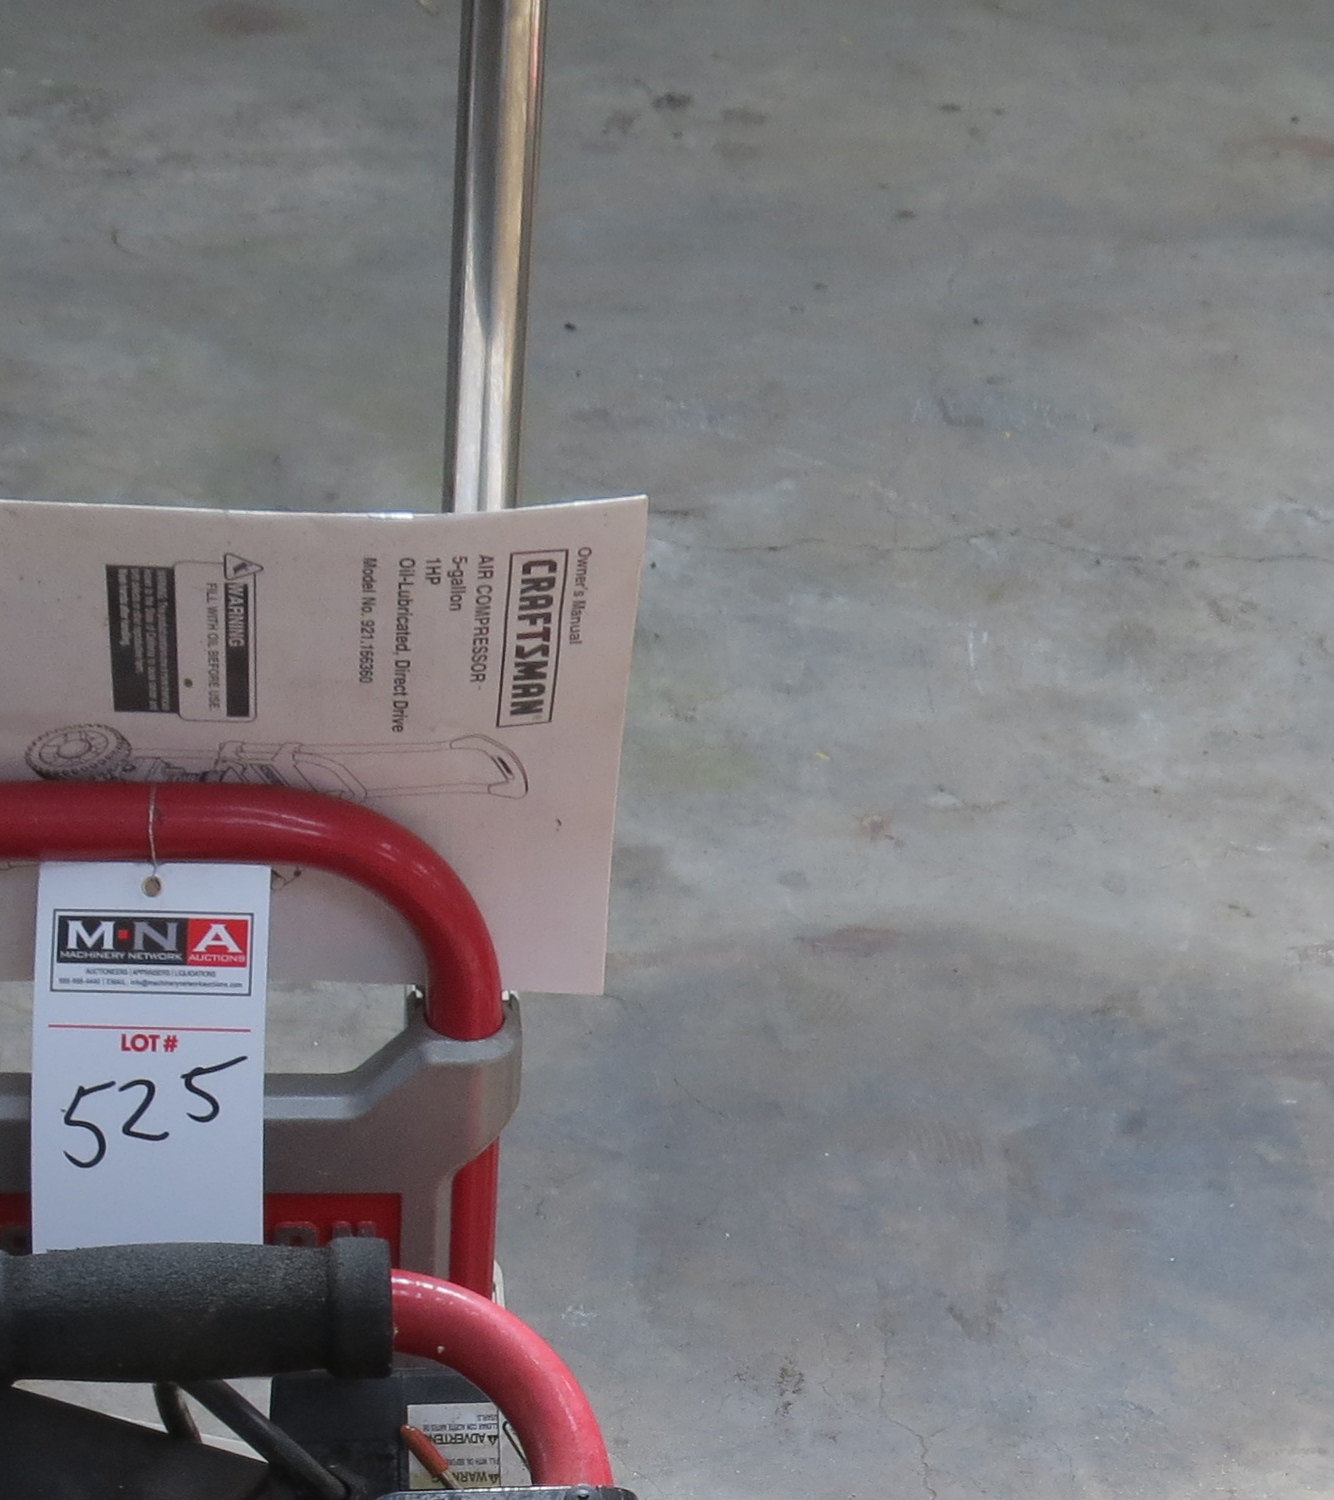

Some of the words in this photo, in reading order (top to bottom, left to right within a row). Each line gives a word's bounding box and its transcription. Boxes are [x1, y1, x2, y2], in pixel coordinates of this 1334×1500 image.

[361, 558, 377, 592] Model
[426, 558, 441, 585] 1HP
[448, 556, 467, 611] 5-gallon
[477, 555, 493, 580] AIR
[573, 547, 592, 597] Owner's
[207, 583, 218, 603] FILL
[361, 597, 376, 616] No.
[393, 558, 415, 655] Oil-Lubricated,
[207, 607, 218, 630] WITH
[228, 584, 245, 647] WARNING
[569, 600, 586, 644] Manual
[207, 633, 218, 648] OIL
[470, 585, 492, 682] COMPRESSOR
[510, 560, 557, 716] CRAFTSMAN
[208, 651, 219, 687] BEFORE
[393, 660, 410, 696] Direct
[209, 690, 219, 711] USE.
[392, 700, 408, 733] Drive
[59, 950, 125, 961] MACHINERY
[128, 951, 183, 962] NETWORK
[189, 953, 245, 963] AUCTIONS
[121, 1034, 159, 1052] LOT
[164, 1035, 178, 1052] #
[61, 1055, 247, 1169] 525
